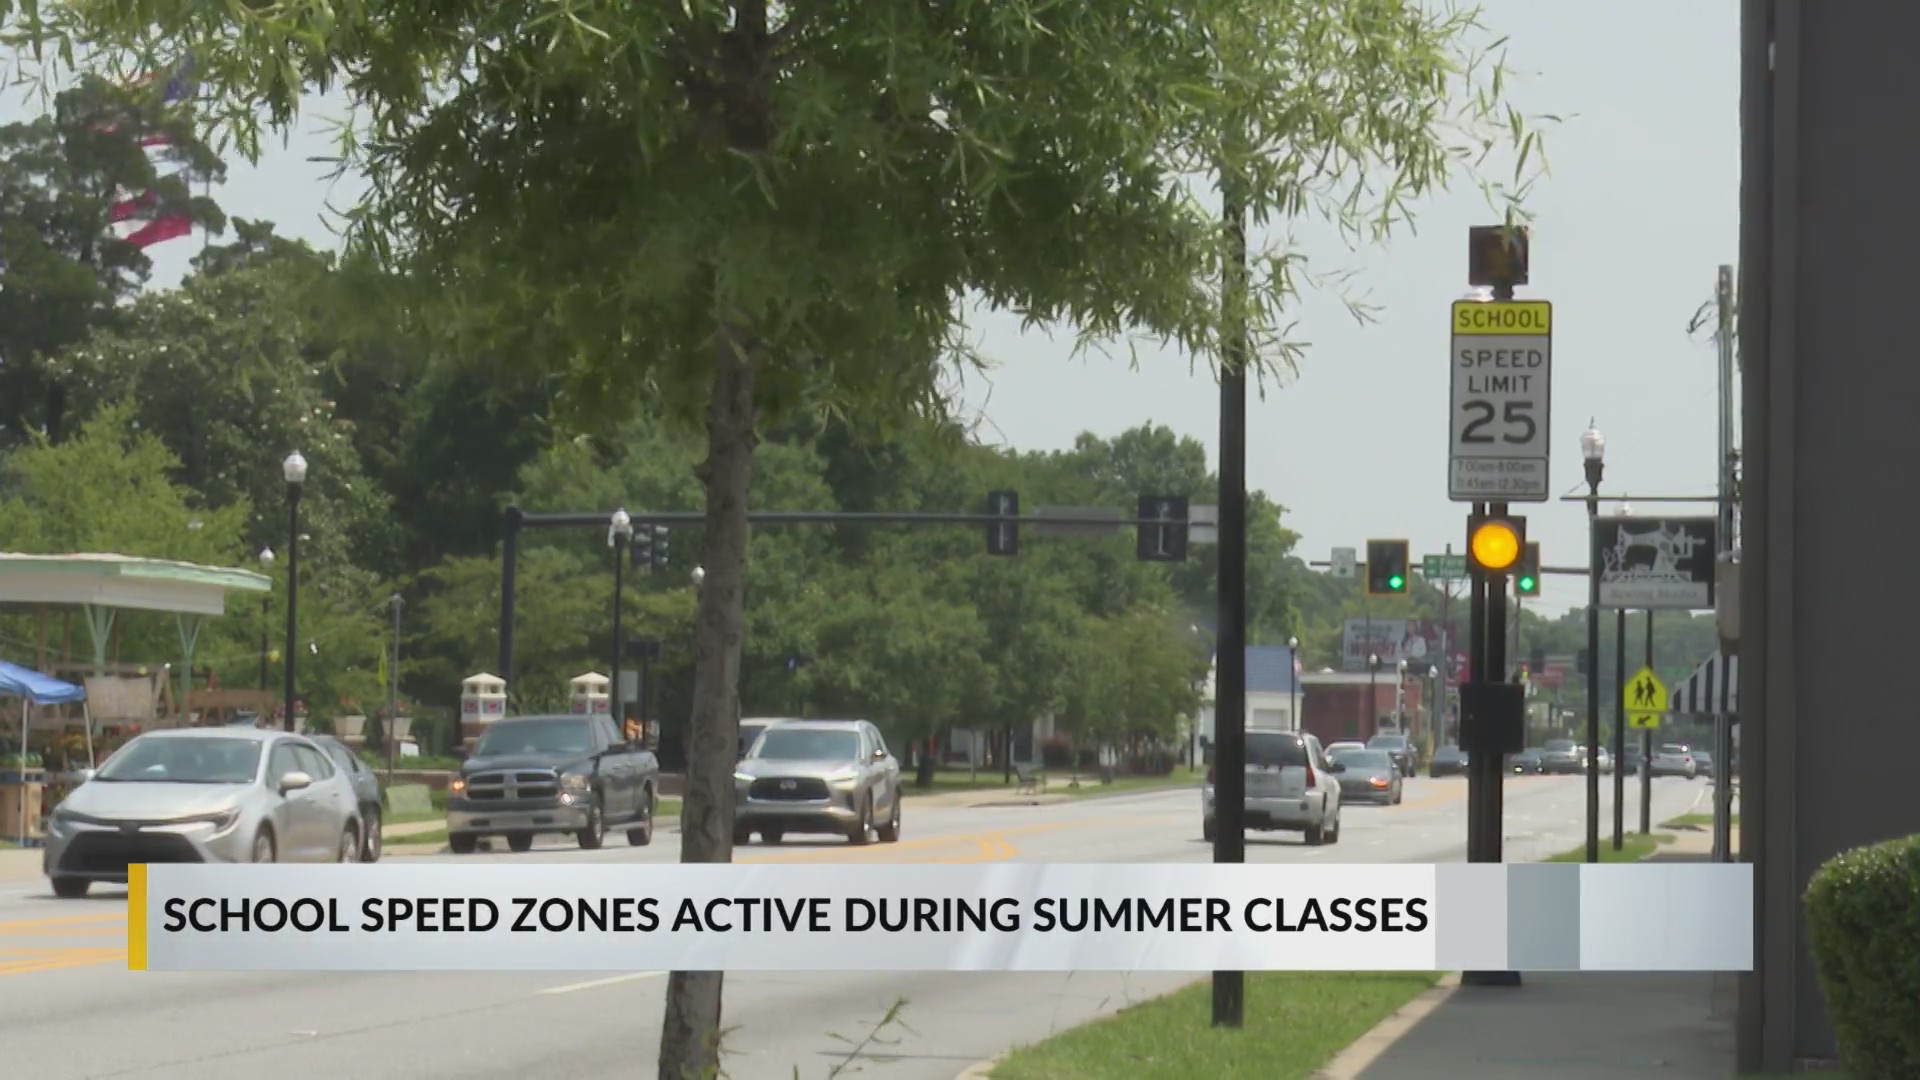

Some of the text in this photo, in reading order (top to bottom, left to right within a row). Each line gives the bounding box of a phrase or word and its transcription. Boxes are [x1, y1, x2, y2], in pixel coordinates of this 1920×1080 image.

[1459, 308, 1545, 328] SCHOOL
[1460, 349, 1542, 369] SPEED
[1468, 374, 1533, 393] LIMIT
[1461, 399, 1536, 444] 25
